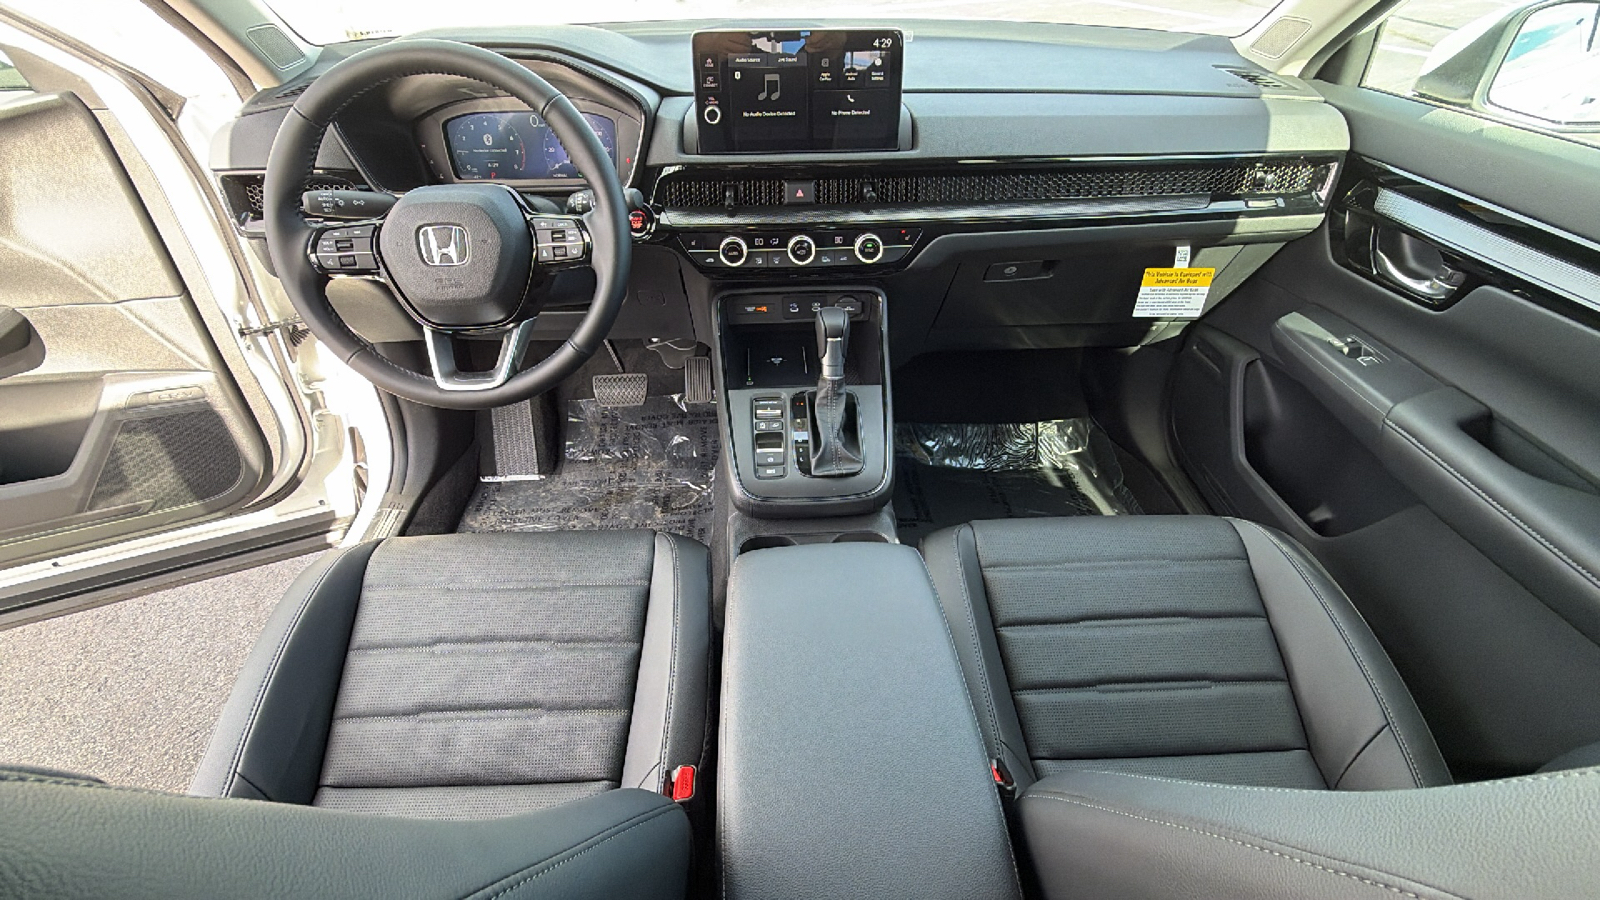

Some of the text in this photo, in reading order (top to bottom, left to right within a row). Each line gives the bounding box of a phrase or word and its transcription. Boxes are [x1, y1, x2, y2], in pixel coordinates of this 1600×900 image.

[873, 38, 893, 48] 4:29
[530, 114, 539, 128] 0
[490, 171, 496, 179] P
[1179, 271, 1202, 279] Equipped
